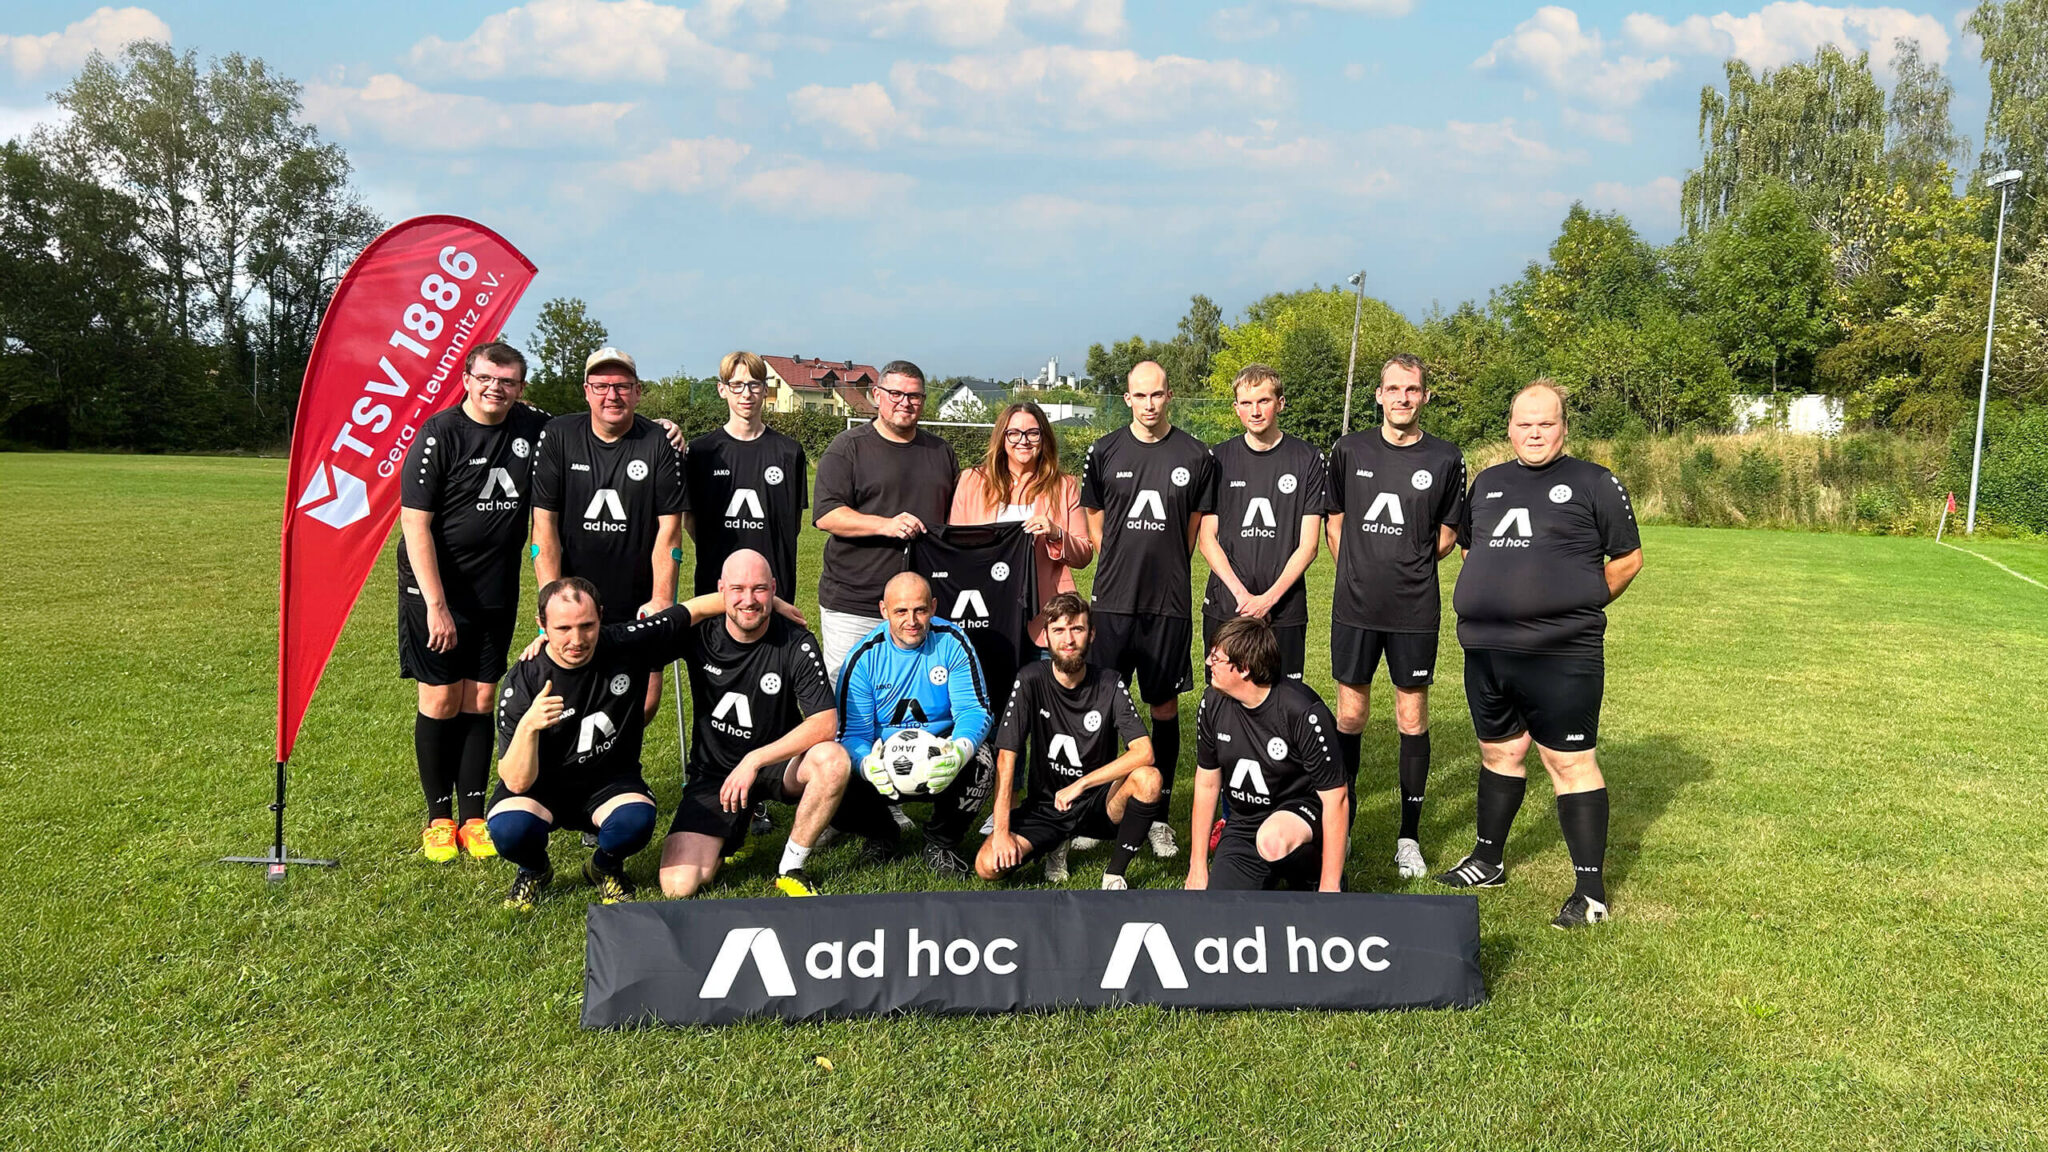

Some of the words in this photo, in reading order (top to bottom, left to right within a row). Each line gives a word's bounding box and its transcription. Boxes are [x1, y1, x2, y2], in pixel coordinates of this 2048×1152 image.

[331, 355, 411, 459] TSV
[388, 245, 478, 360] 1886
[377, 426, 416, 478] Gera
[416, 307, 481, 405] Leumnitz
[475, 271, 506, 307] e.V.
[476, 500, 494, 511] ad
[496, 500, 518, 510] hoc
[583, 520, 601, 531] ad
[602, 520, 627, 532] hoc
[724, 519, 740, 529] ad
[742, 519, 764, 529] hoc
[1126, 520, 1142, 529] ad
[1143, 520, 1166, 531] hoc
[1362, 522, 1379, 533] ad
[1380, 523, 1403, 536] hoc
[1241, 527, 1254, 538] ad
[1255, 527, 1276, 538] hoc
[1489, 537, 1505, 547] ad
[1505, 537, 1530, 548] hoc
[967, 619, 989, 629] hoc
[711, 719, 726, 732] ad
[727, 724, 752, 739] hoc
[1060, 764, 1083, 777] hoc
[1231, 790, 1245, 802] ad
[1247, 793, 1271, 805] hoc
[805, 928, 885, 980] ad
[907, 928, 1019, 977] hoc
[1193, 925, 1268, 974] ad
[1286, 925, 1392, 973] hoc
